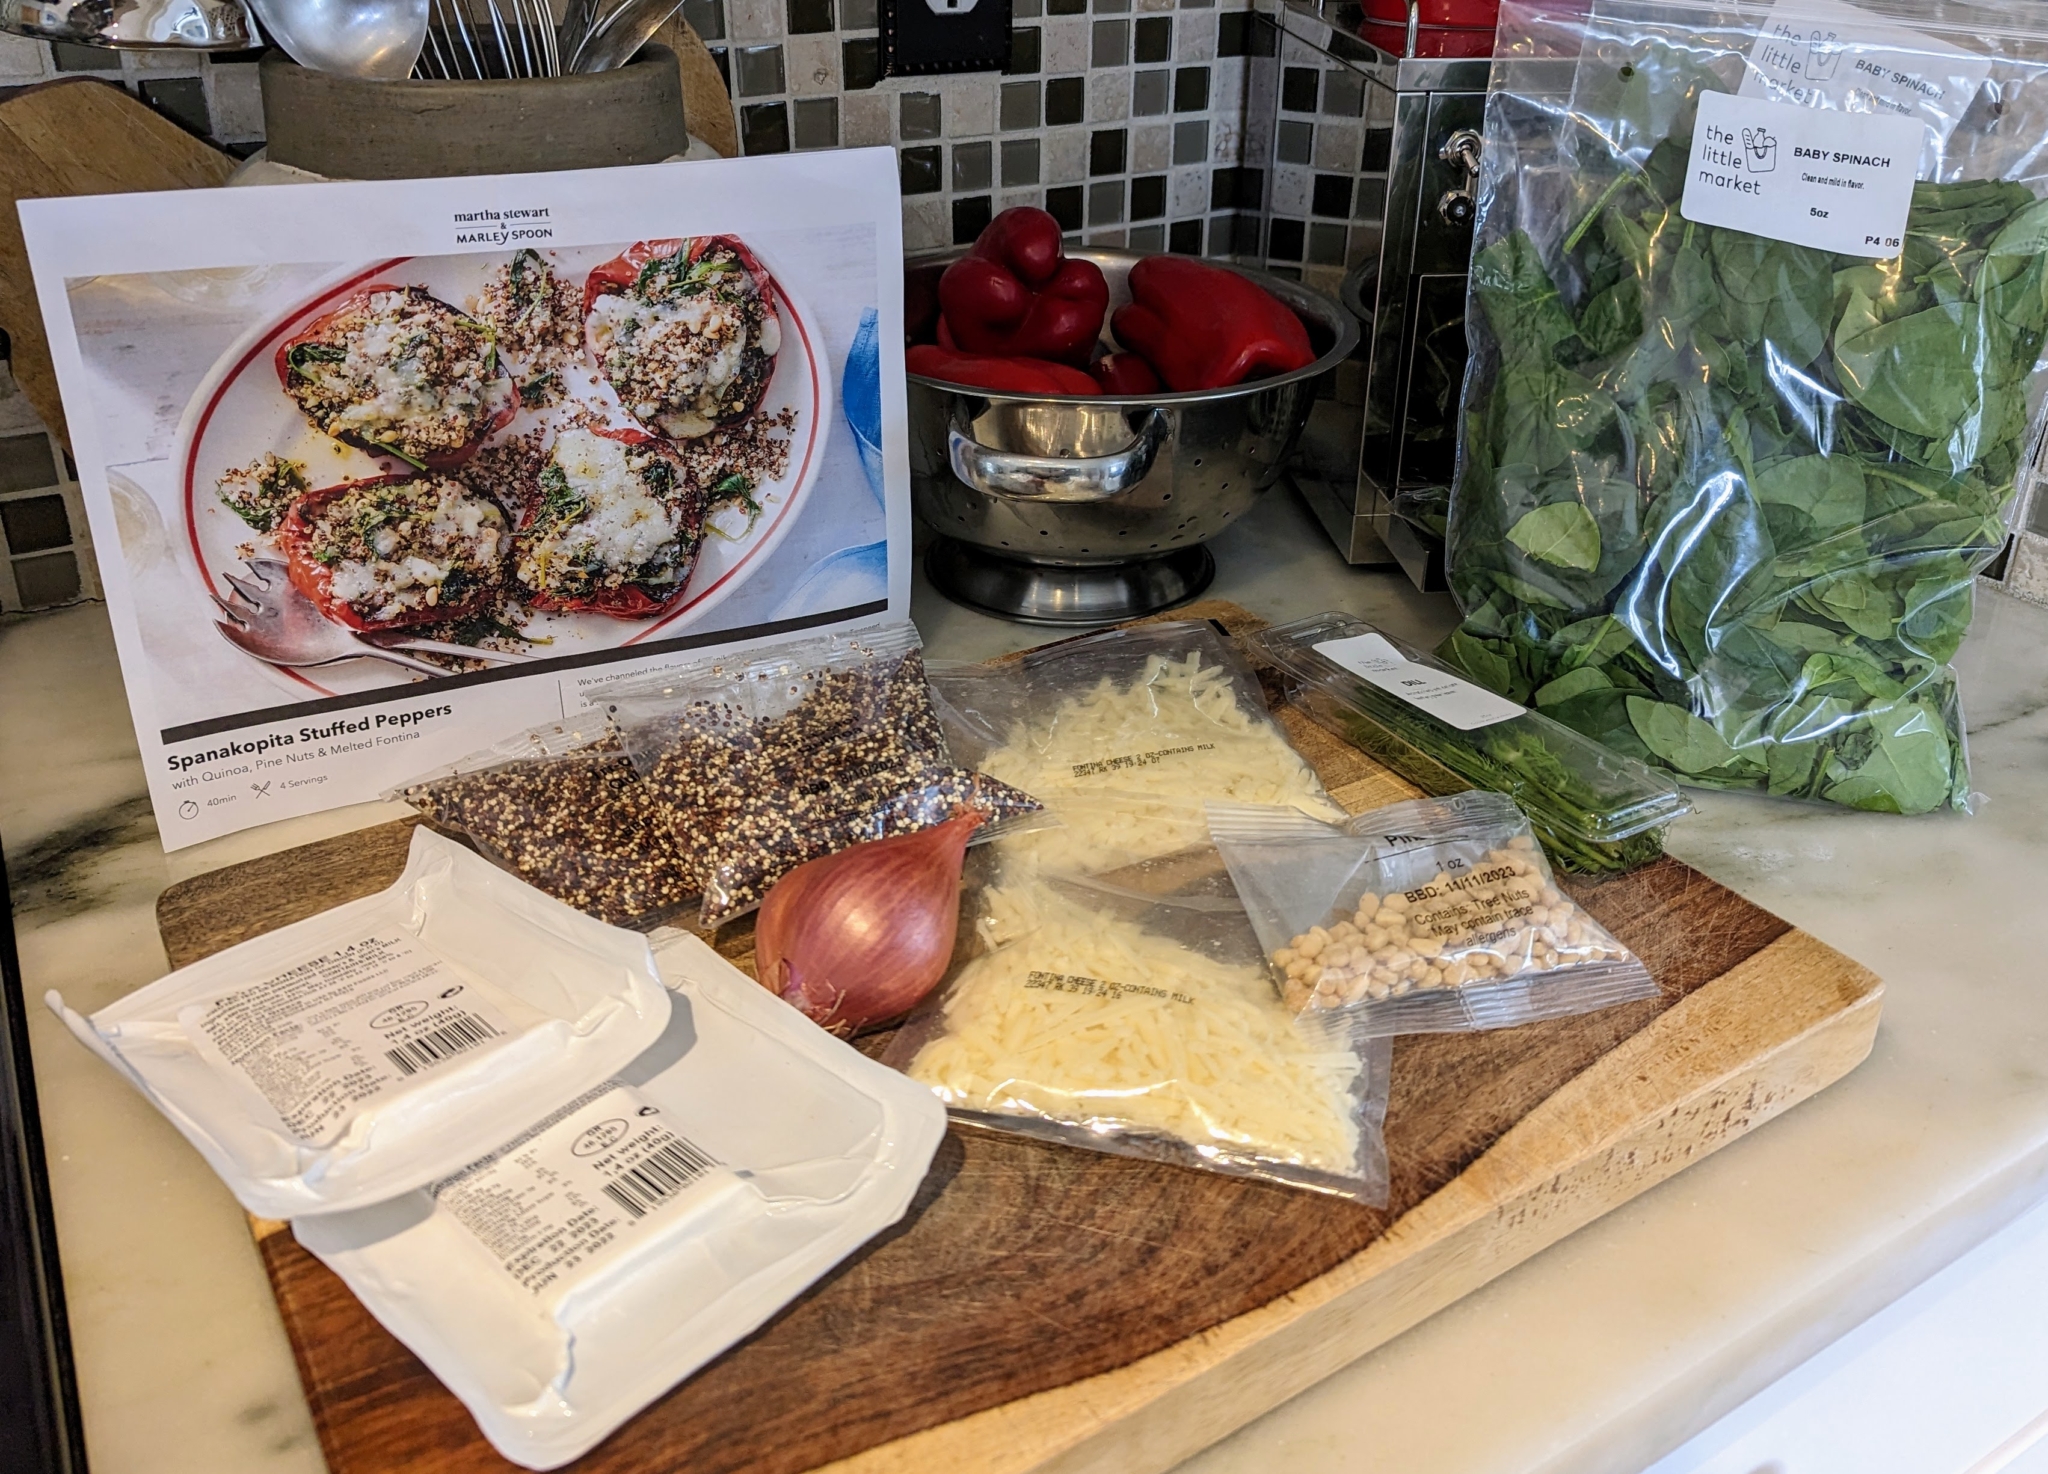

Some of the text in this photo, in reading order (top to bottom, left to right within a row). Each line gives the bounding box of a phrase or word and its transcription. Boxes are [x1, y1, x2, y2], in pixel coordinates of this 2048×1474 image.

[1760, 44, 1801, 74] little
[1855, 59, 1946, 100] BABY SPINACH
[1706, 125, 1734, 145] the
[1702, 144, 1742, 169] little
[1794, 147, 1891, 168] BABY SPINACH
[1699, 171, 1761, 196] market
[1801, 172, 1817, 183] Clean
[1817, 174, 1828, 184] and
[1828, 176, 1841, 187] mild
[1847, 178, 1865, 190] flavor.
[454, 207, 549, 222] martha stewart
[1809, 207, 1829, 219] 5oz
[511, 229, 553, 240] SPOON
[1865, 236, 1900, 247] P4 06
[577, 677, 604, 686] We've
[167, 704, 453, 772] Spanakopita Stuffed Peppers
[1197, 743, 1216, 751] MILK
[171, 730, 421, 790] with Quinoa, Pine Nuts & Melted Fontina
[279, 774, 329, 790] 4 Servings
[207, 794, 237, 807] 40min
[1436, 858, 1464, 872] 1 oz
[1404, 866, 1516, 903] BBD: 11/11/2023
[1414, 889, 1530, 925] Contains: Tree Nuts
[1429, 905, 1534, 937] May contain trace
[1466, 927, 1516, 947] allergens
[1028, 970, 1065, 982] FONTINA
[1171, 993, 1196, 1005] MILK
[384, 1026, 408, 1039] Net
[410, 1005, 460, 1028] weight:
[592, 1153, 617, 1171] Net
[616, 1125, 663, 1155] weight:
[625, 1152, 642, 1164] oz
